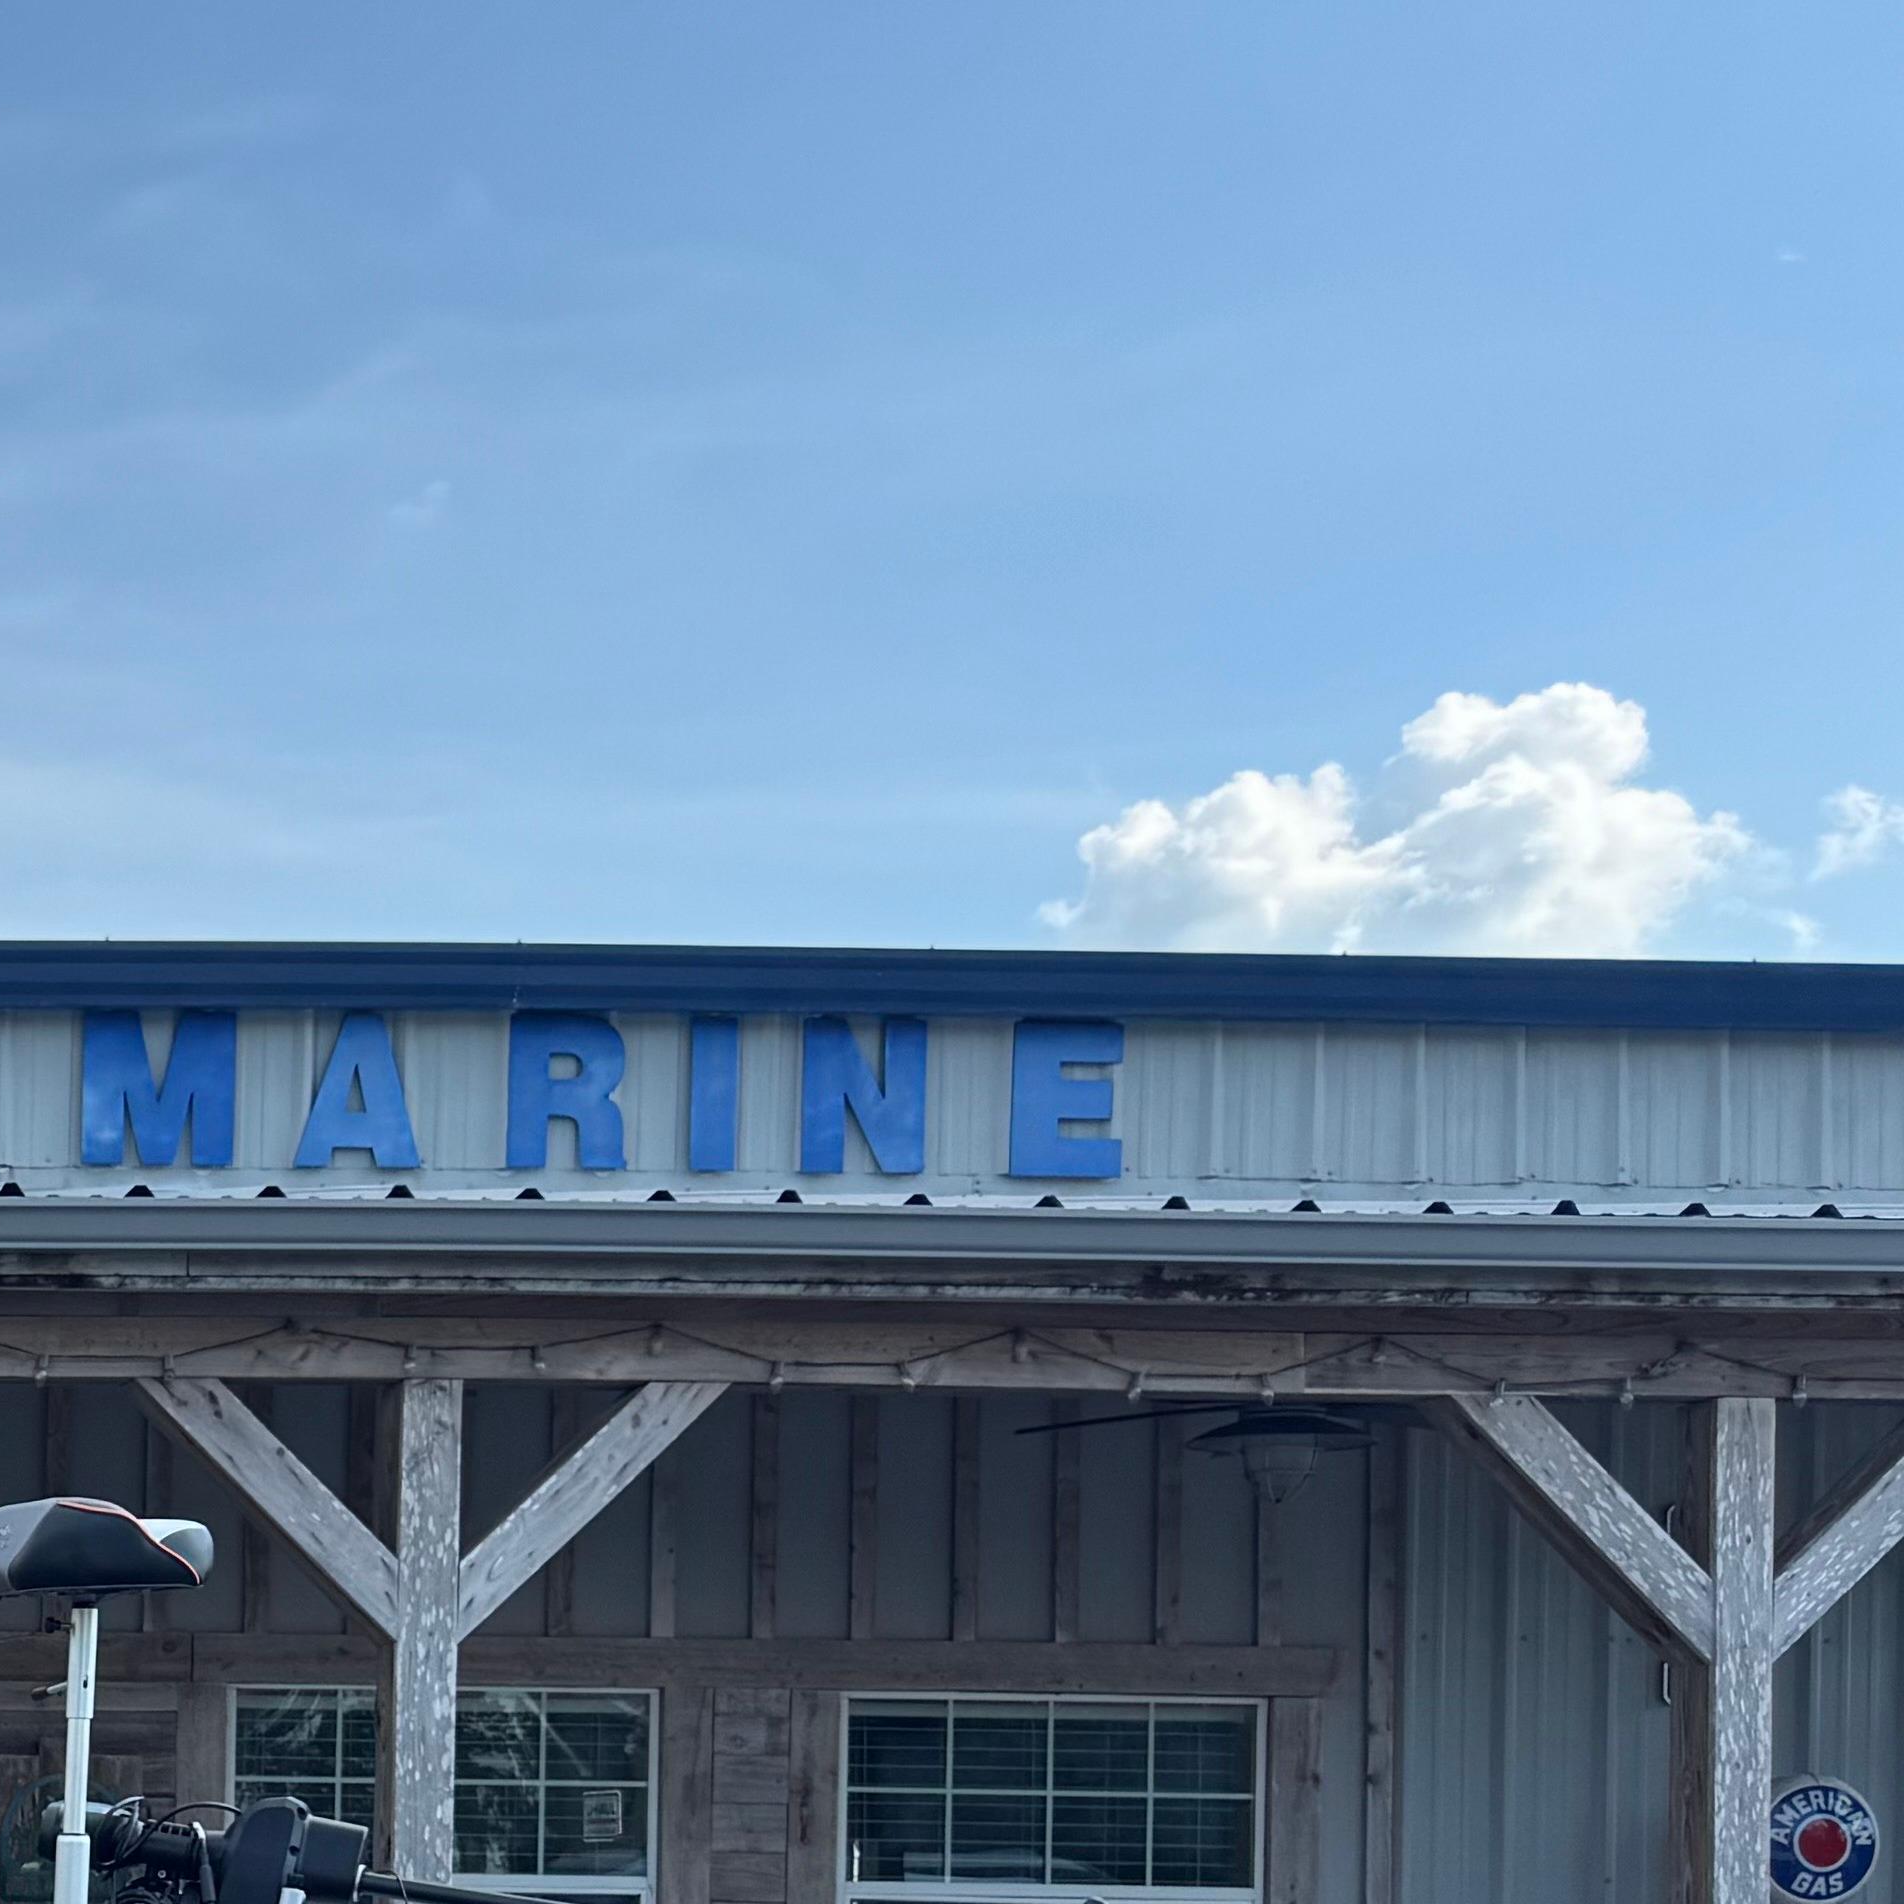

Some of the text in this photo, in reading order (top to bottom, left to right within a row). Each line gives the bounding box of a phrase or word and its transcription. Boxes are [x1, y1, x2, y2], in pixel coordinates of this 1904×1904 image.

[80, 1010, 1124, 1178] MARINE
[1771, 1789, 1873, 1847] AMERICAN
[1791, 1871, 1844, 1896] GAS
